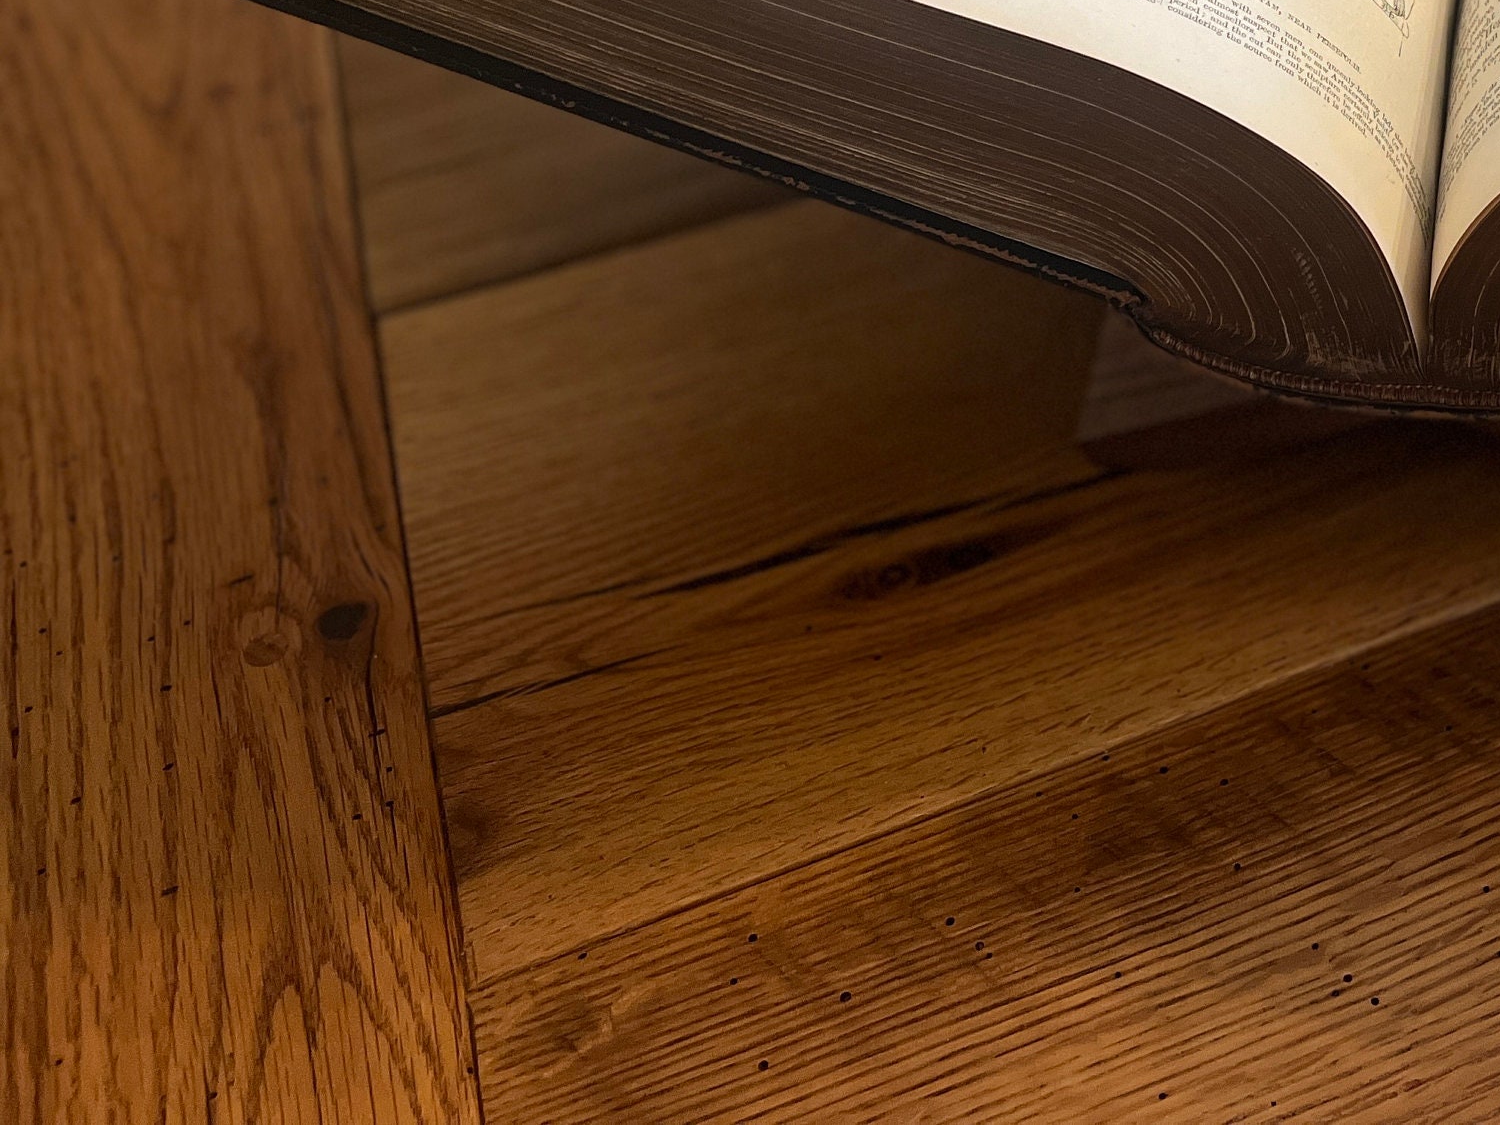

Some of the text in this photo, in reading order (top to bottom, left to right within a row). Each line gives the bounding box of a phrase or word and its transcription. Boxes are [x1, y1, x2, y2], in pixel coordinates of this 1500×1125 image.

[1231, 0, 1252, 15] with
[1256, 14, 1281, 33] seven
[1287, 13, 1312, 33] NEAR
[1168, 5, 1294, 77] considering the source from
